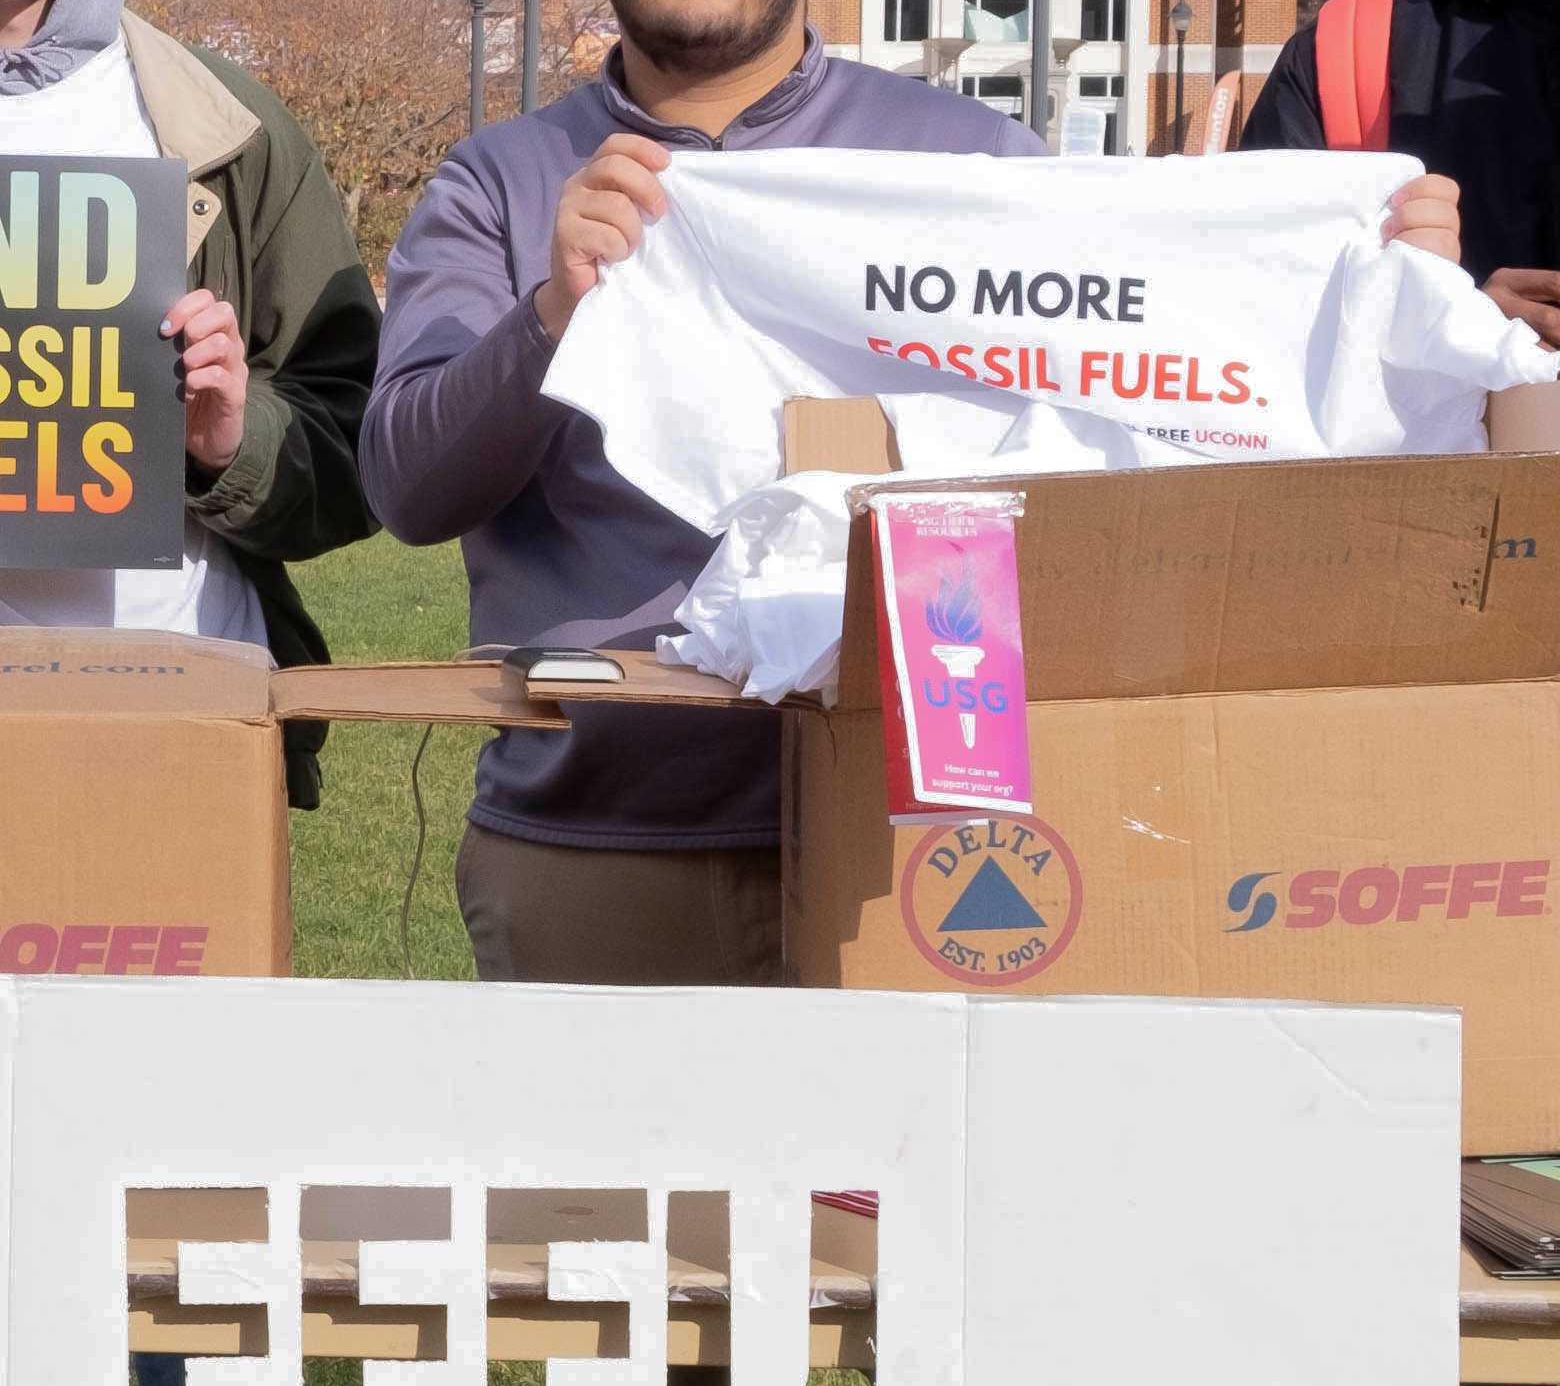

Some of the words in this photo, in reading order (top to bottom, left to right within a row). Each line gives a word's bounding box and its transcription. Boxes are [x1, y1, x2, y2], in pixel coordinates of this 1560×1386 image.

[865, 264, 957, 314] NO
[972, 268, 1146, 323] MORE
[1079, 350, 1268, 408] FUELS.
[1194, 430, 1269, 450] UCONN
[923, 677, 1009, 714] USG
[932, 778, 969, 791] support
[970, 781, 994, 793] your
[994, 783, 1014, 797] org?
[944, 764, 966, 775] How
[967, 766, 985, 777] can
[986, 769, 1000, 778] we
[928, 820, 1052, 879] DELTA
[1284, 859, 1552, 929] SOFFE
[938, 937, 986, 972] EST.
[997, 936, 1047, 972] 1903
